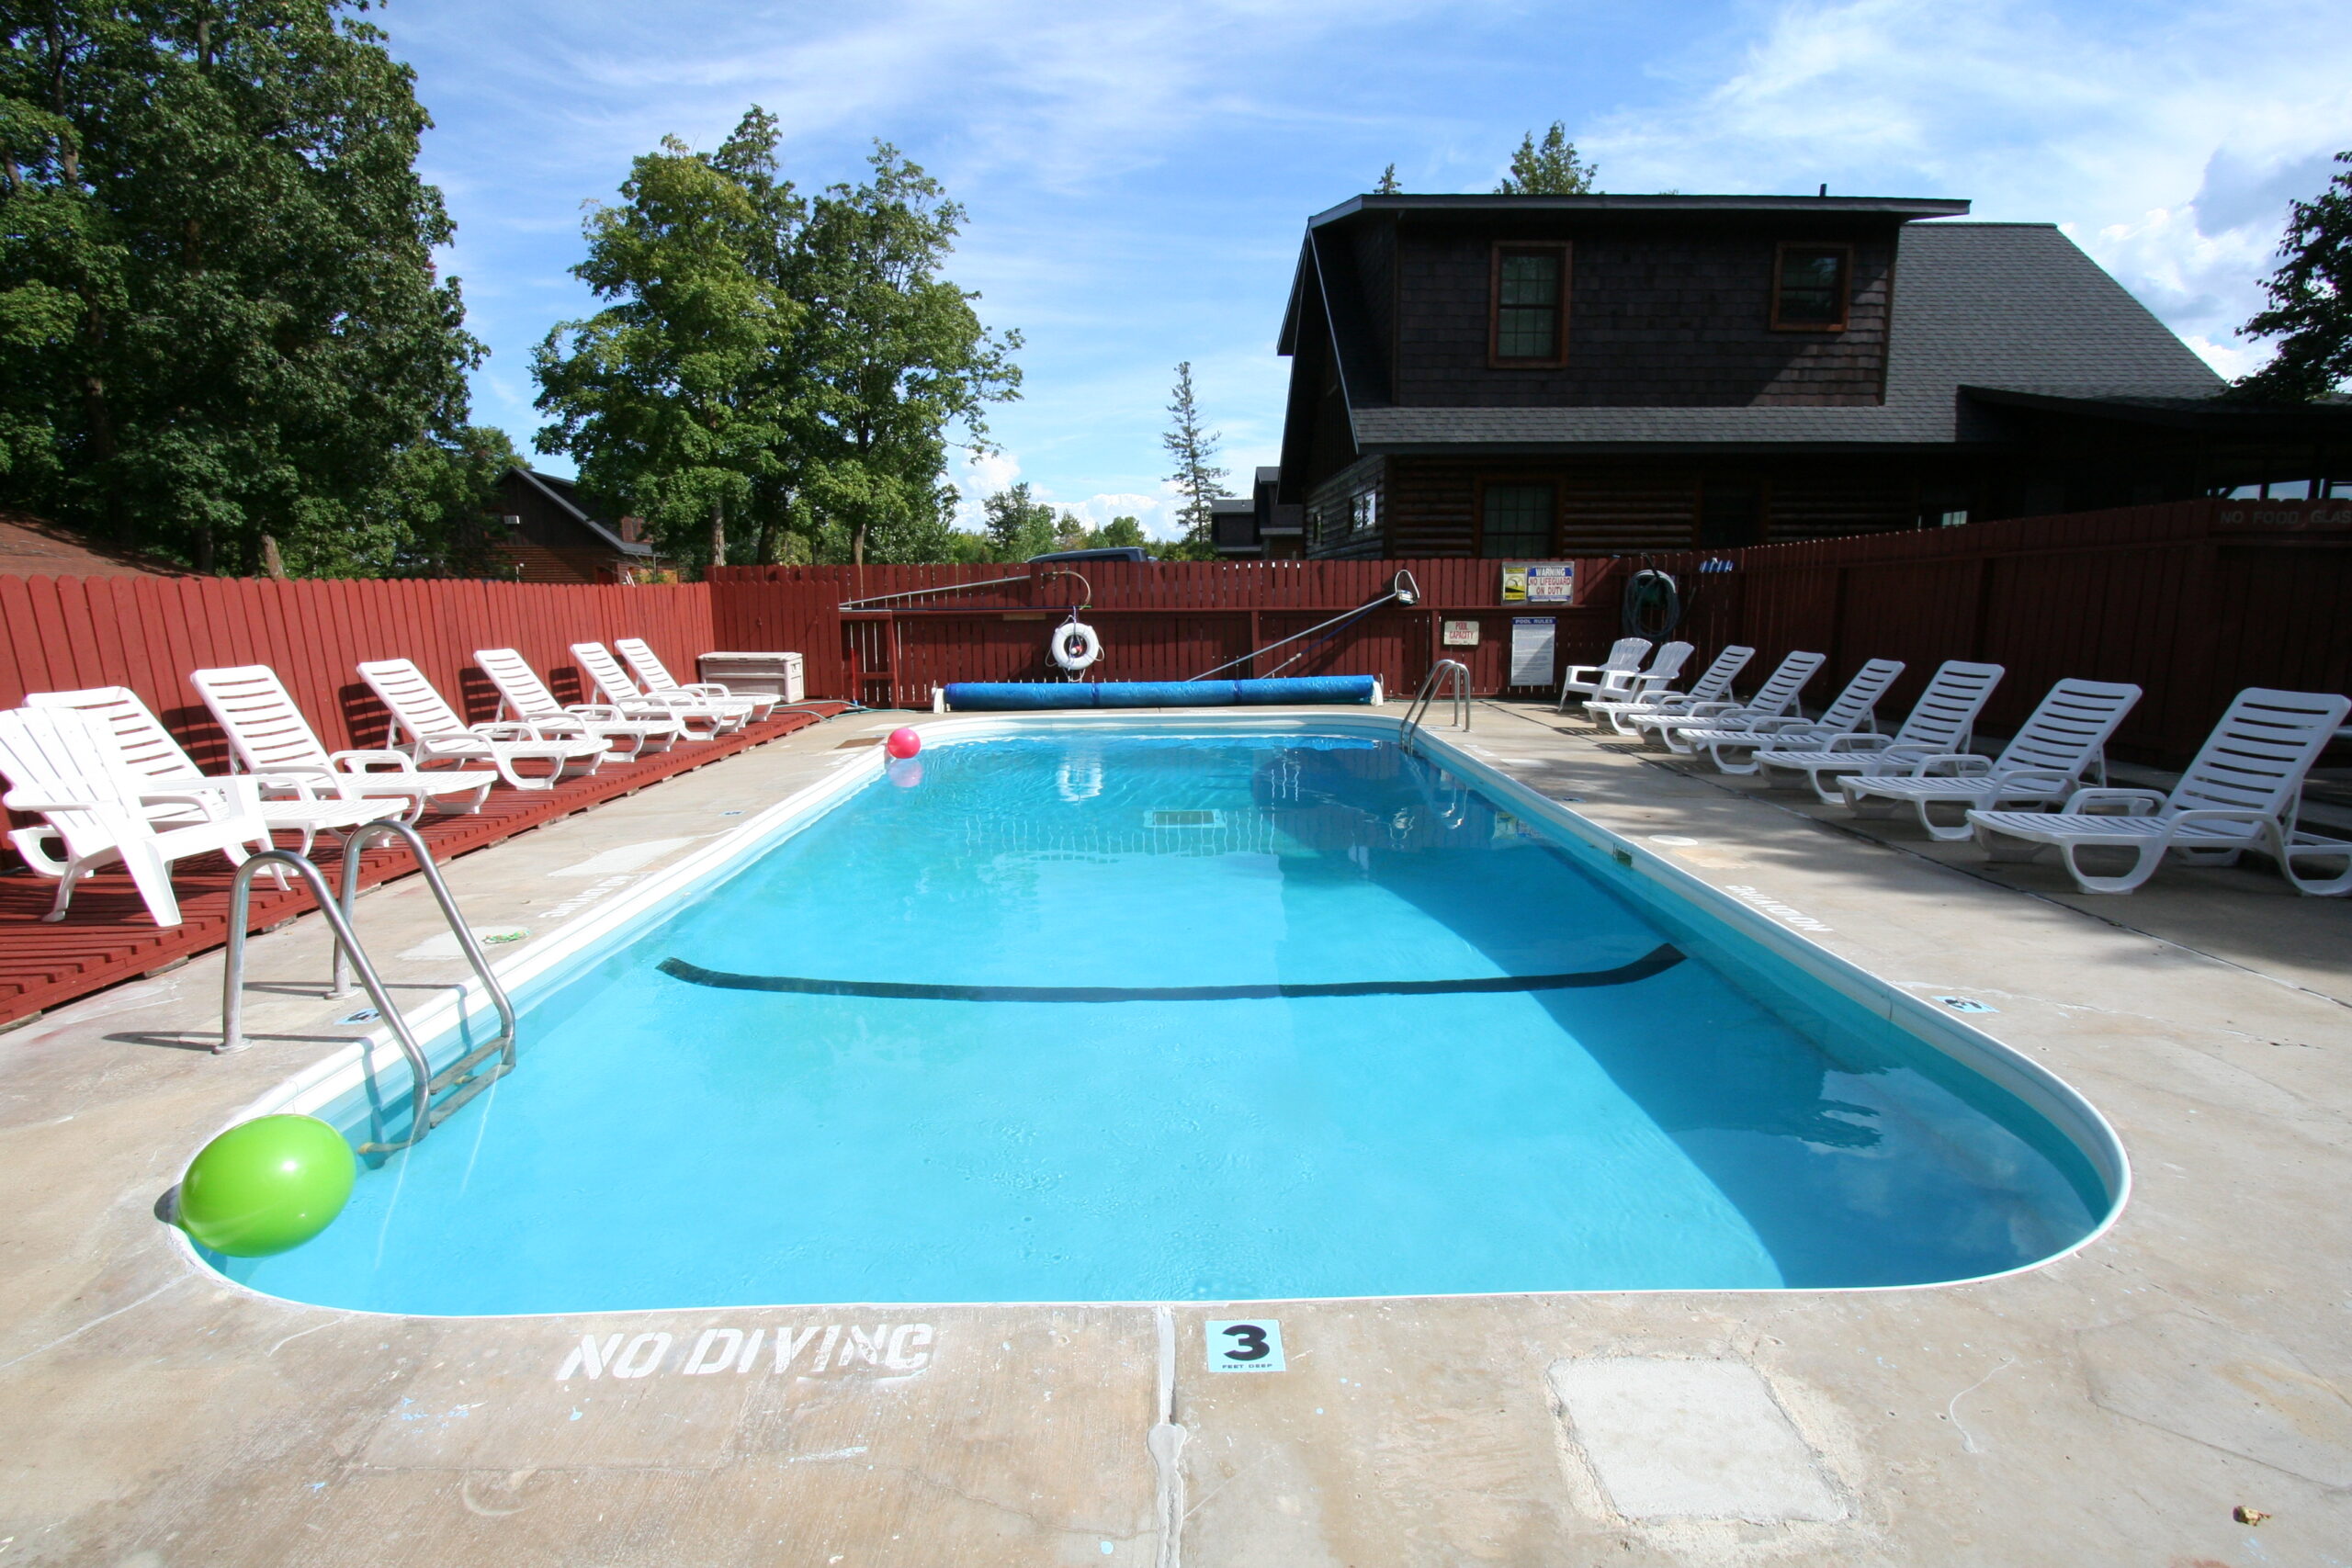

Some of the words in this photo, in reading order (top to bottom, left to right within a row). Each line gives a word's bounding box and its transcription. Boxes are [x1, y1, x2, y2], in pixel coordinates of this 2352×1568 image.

[2220, 511, 2245, 524] NO
[2253, 511, 2300, 524] FOOD
[1535, 568, 1566, 577] WARNING
[1529, 577, 1538, 585] NO
[1540, 577, 1571, 585] LIFEGUARD
[1536, 586, 1545, 595] ON
[1547, 586, 1564, 595] DUTY
[1455, 621, 1467, 630] POOL
[1449, 630, 1475, 639] CAPACITY
[1222, 1324, 1271, 1361] 3
[555, 1332, 673, 1381] NO
